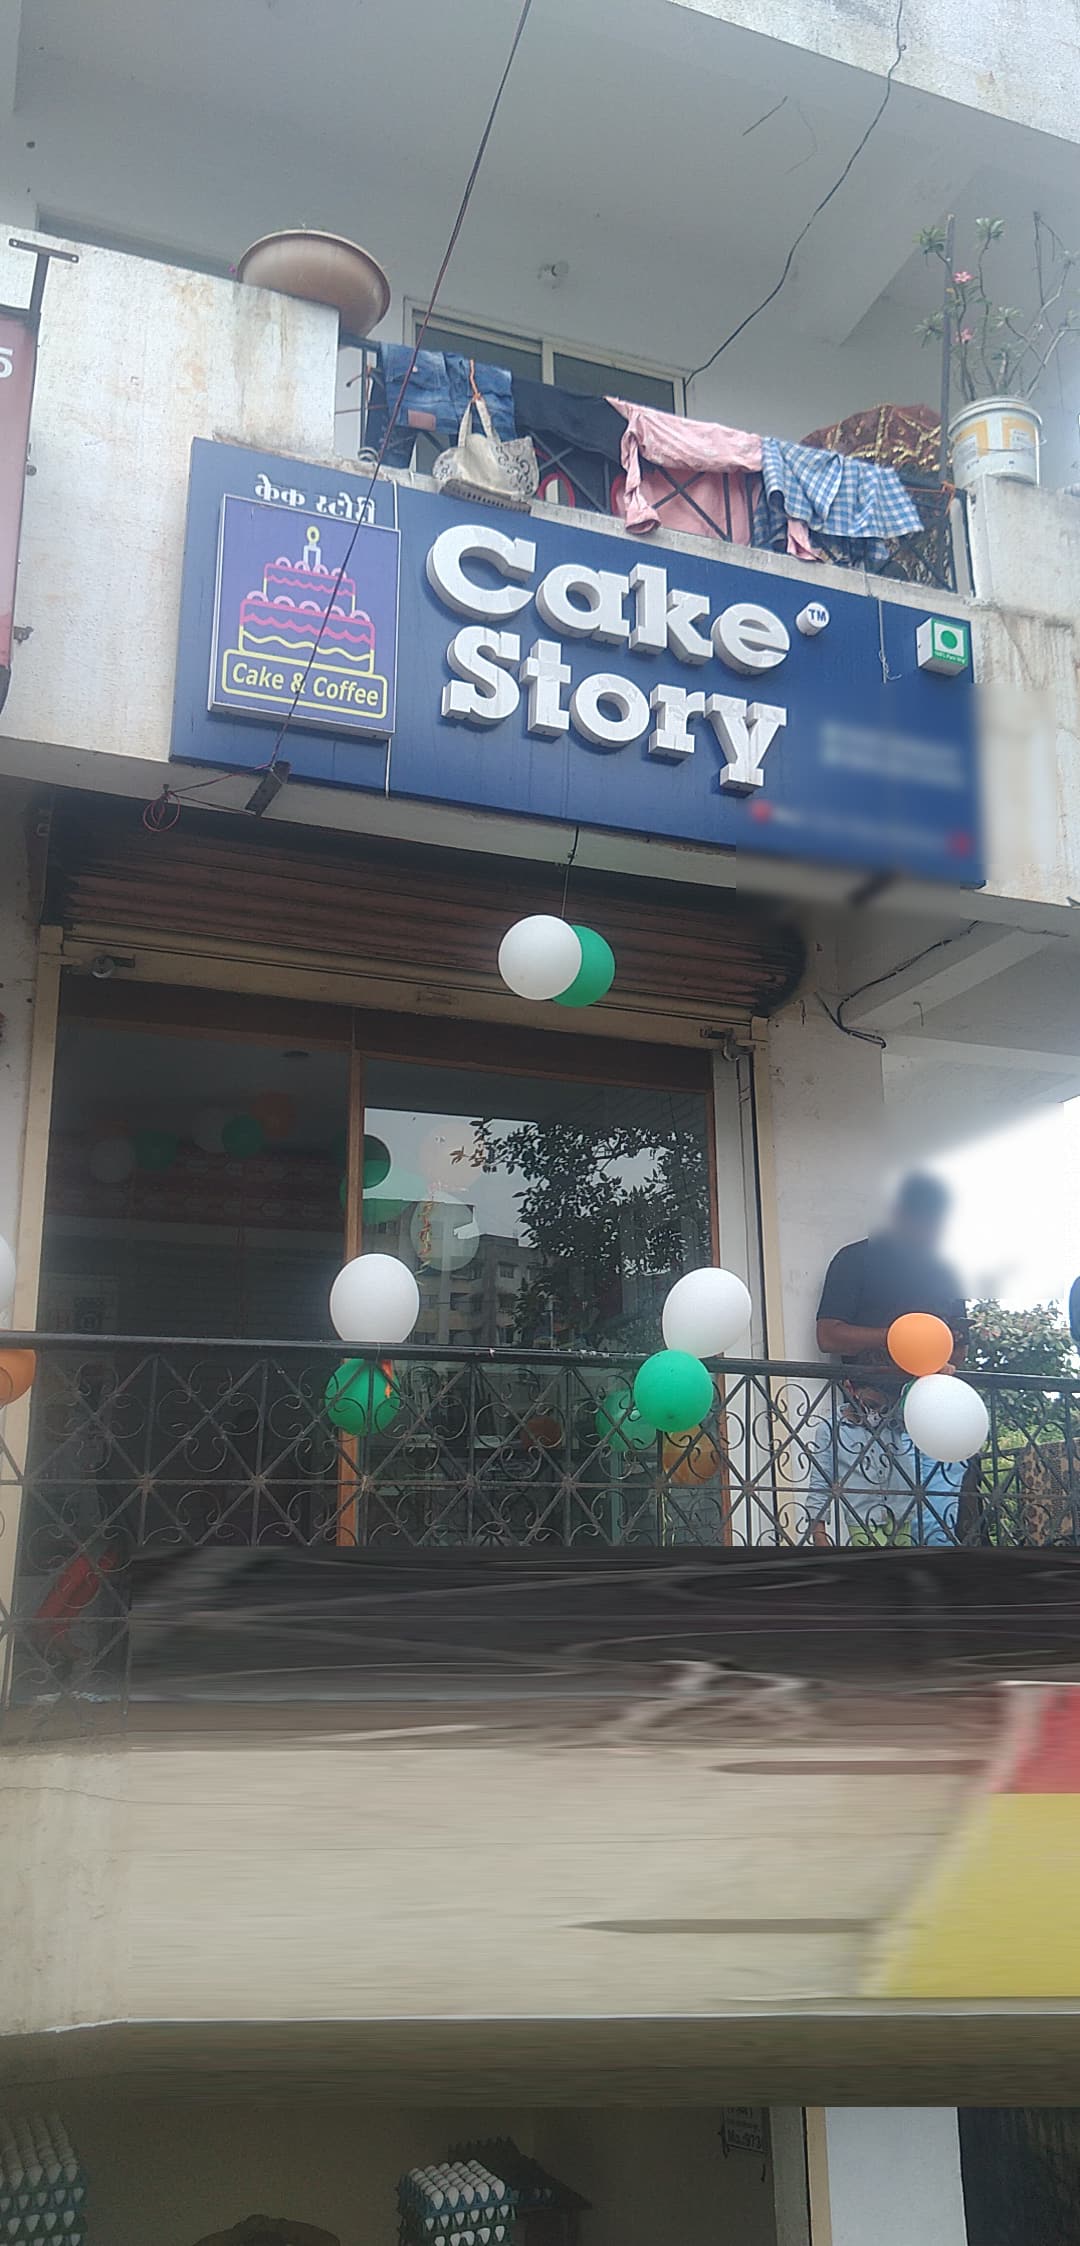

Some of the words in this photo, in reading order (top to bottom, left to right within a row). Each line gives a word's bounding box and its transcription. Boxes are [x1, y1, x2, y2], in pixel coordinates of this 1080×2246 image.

[254, 473, 306, 507] केक
[315, 492, 376, 524] स्टोरी
[426, 524, 790, 674] Cake
[808, 609, 827, 623] TM
[232, 661, 284, 690] Cake
[290, 671, 306, 696] &
[312, 676, 379, 707] Coffee
[441, 625, 788, 791] Story
